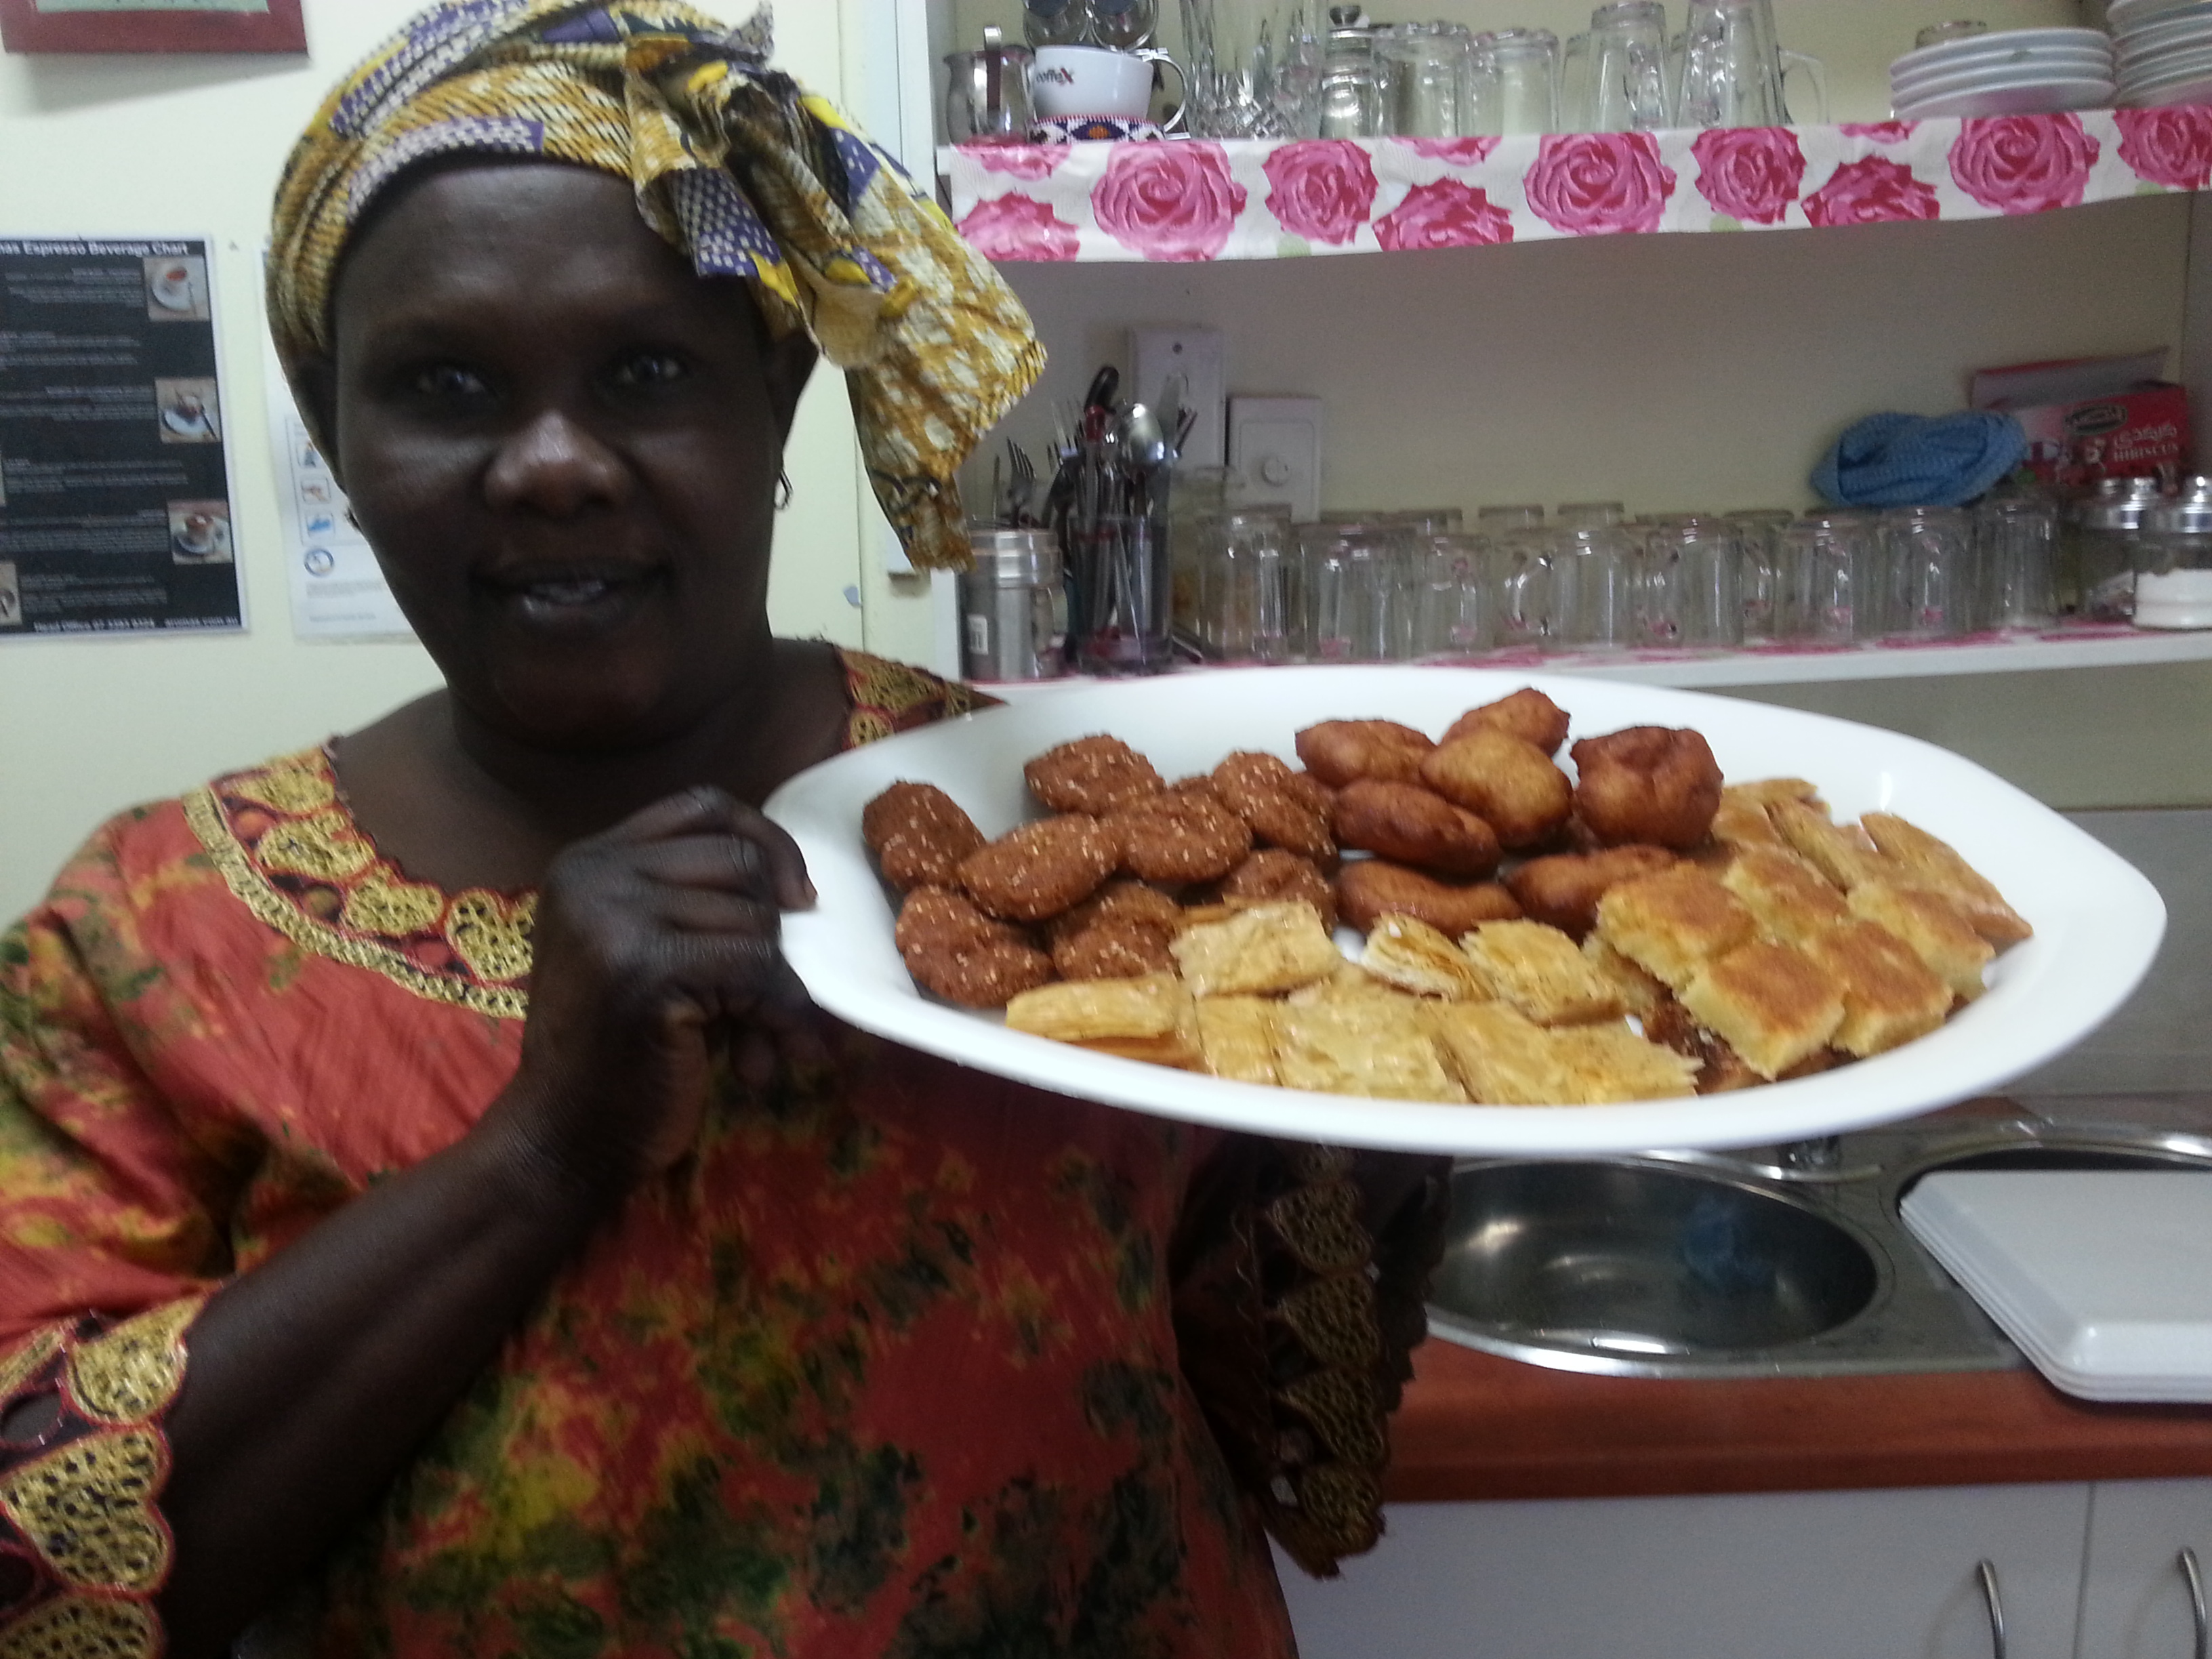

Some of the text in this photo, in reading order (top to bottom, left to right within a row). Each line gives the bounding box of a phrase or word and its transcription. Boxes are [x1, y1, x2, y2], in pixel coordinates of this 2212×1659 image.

[22, 241, 86, 257] Espresso
[88, 242, 150, 258] Beverage
[151, 241, 188, 255] Chart
